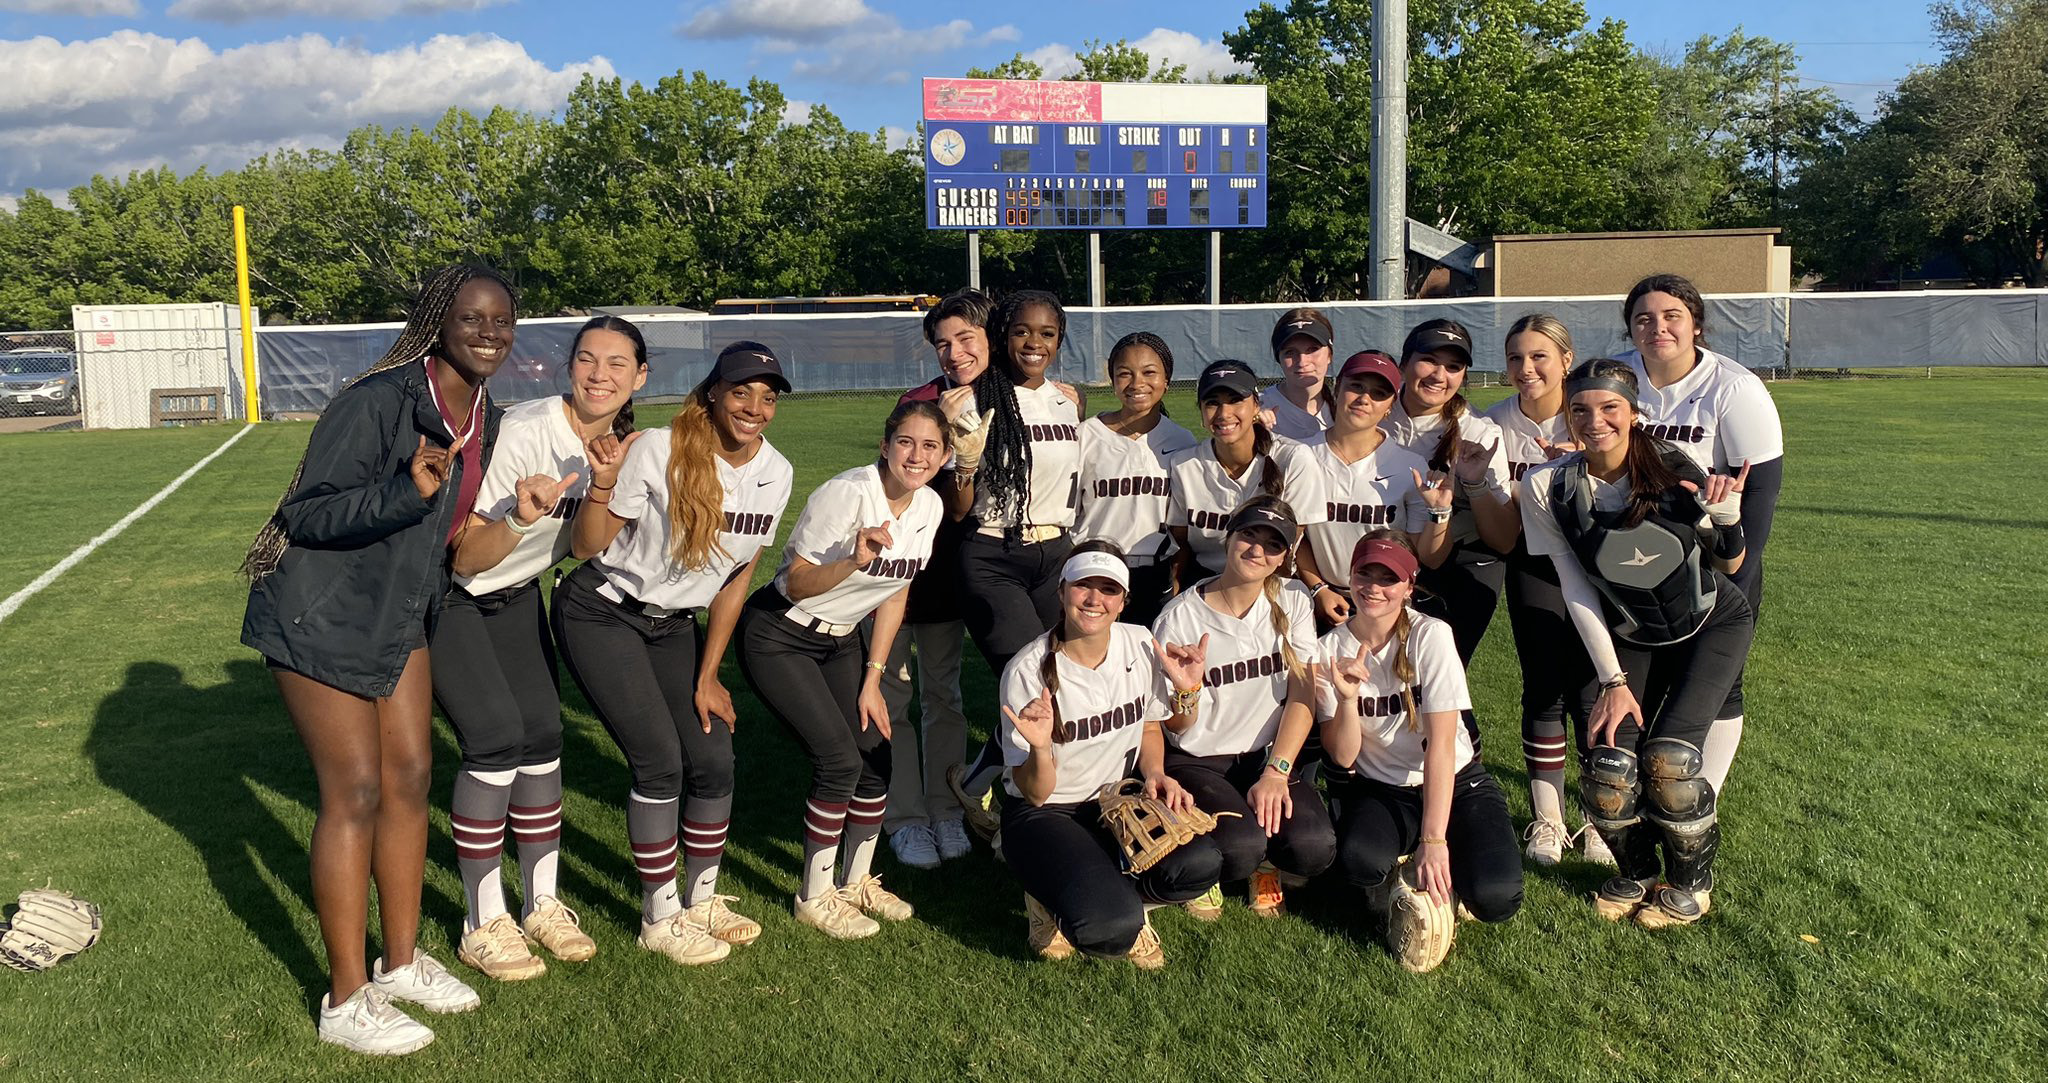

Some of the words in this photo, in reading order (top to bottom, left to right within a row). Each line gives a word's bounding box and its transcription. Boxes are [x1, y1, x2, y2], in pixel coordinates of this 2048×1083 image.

[994, 125, 1007, 144] AT
[1013, 125, 1033, 144] BAT
[1068, 126, 1096, 145] BALL
[1118, 127, 1160, 146] STRIKE
[1178, 128, 1201, 146] OUT
[1249, 128, 1255, 146] E
[1008, 178, 1013, 189] 1
[1020, 178, 1026, 189] 2
[1032, 178, 1038, 189] 3
[1044, 178, 1050, 189] 4
[1057, 178, 1063, 189] 5
[1069, 178, 1075, 189] 6
[1081, 178, 1087, 189] 7
[1093, 178, 1099, 189] 8
[1105, 178, 1111, 189] 9
[1116, 178, 1124, 189] 10
[1147, 178, 1167, 188] RUNS
[1191, 178, 1208, 189] HITS
[1230, 178, 1257, 189] ERRORS
[937, 188, 998, 207] GUESTS
[939, 208, 998, 226] RANGERS
